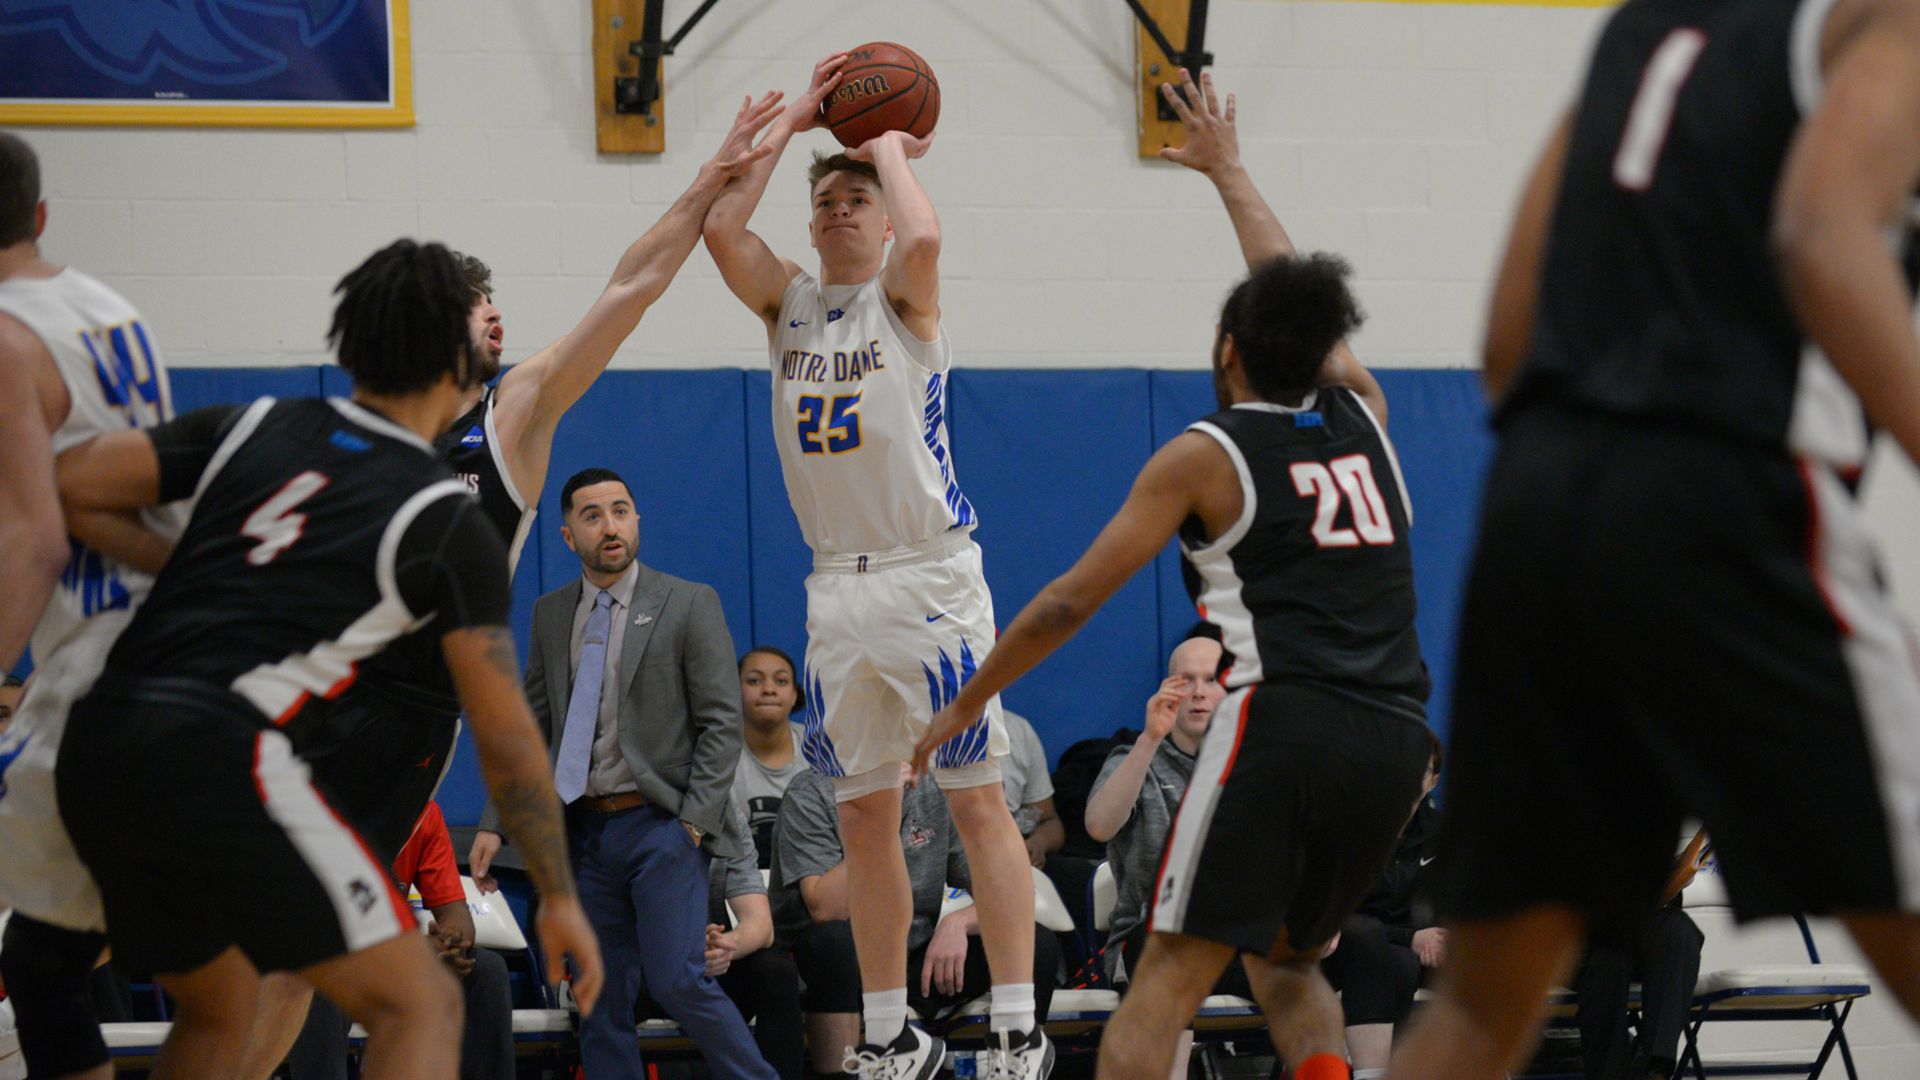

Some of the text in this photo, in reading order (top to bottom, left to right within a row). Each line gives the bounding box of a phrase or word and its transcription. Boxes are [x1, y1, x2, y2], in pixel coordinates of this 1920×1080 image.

[828, 73, 890, 104] Wilso
[1611, 27, 1708, 190] 1
[797, 388, 864, 456] 25
[238, 469, 332, 567] 4
[1289, 453, 1395, 548] 20
